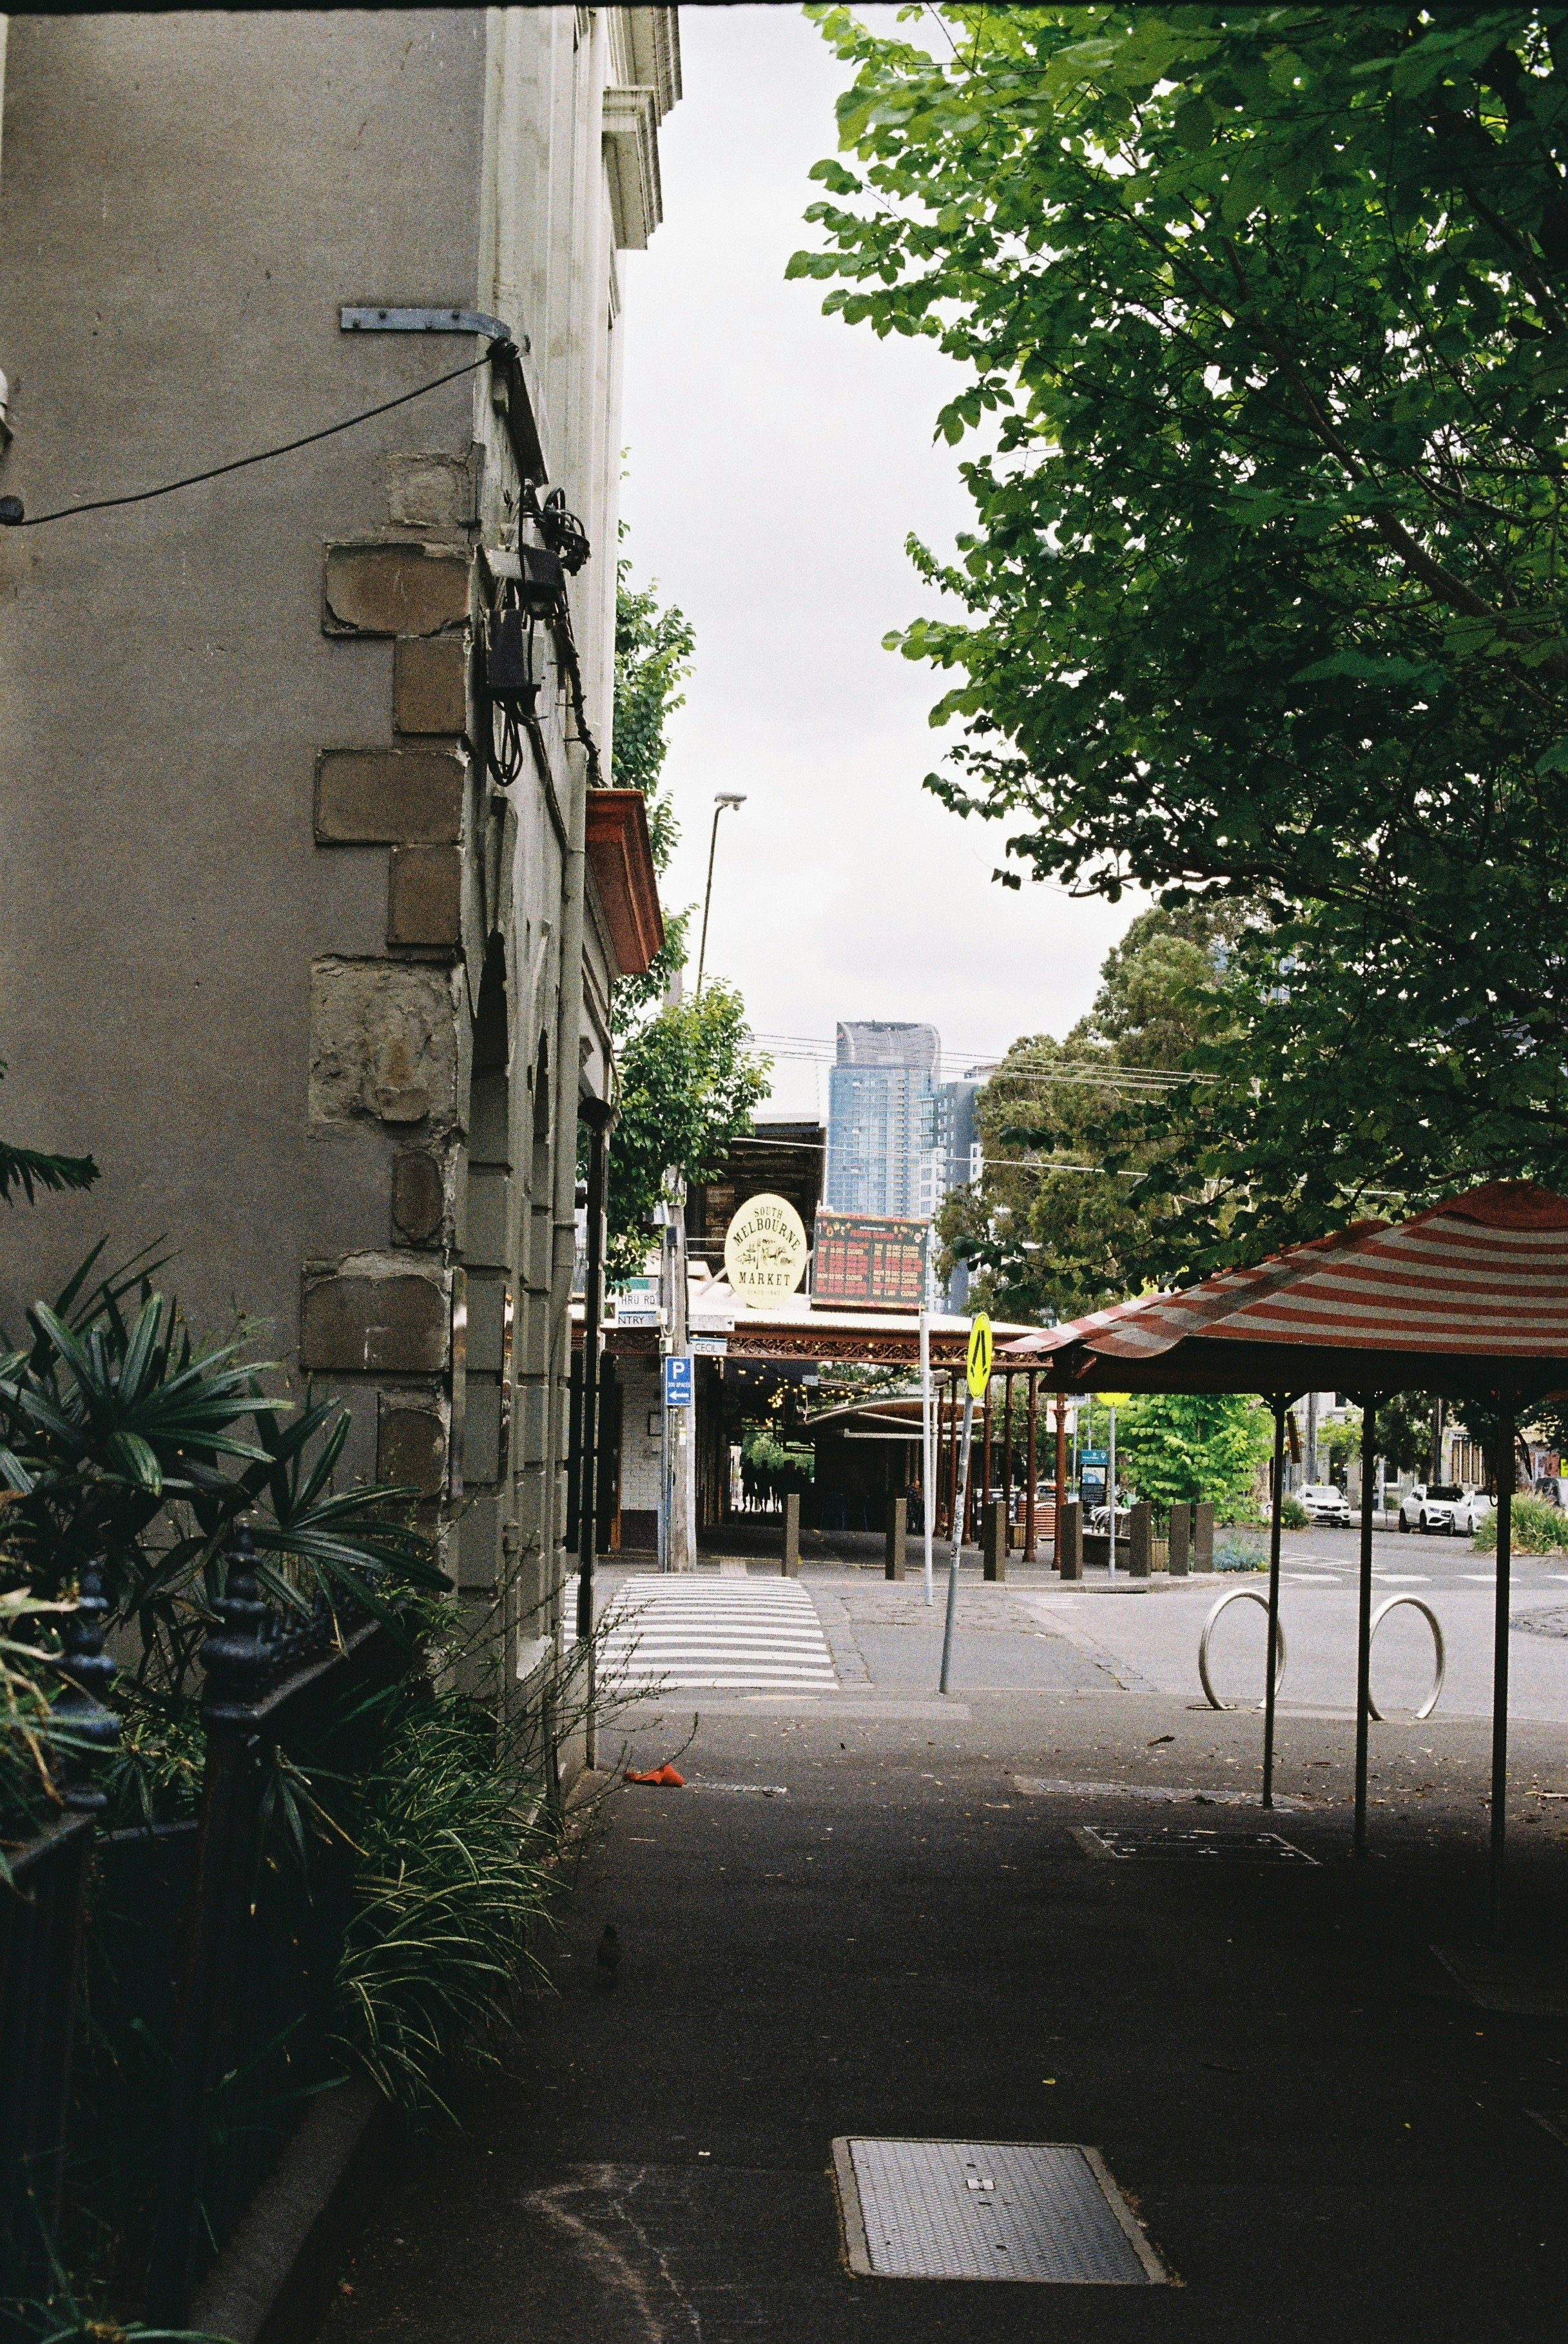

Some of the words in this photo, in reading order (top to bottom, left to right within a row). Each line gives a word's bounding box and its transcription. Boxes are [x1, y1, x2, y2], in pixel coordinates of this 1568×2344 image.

[754, 1206, 783, 1219] SOUTH
[733, 1217, 801, 1252] MELBOURNE
[739, 1272, 790, 1286] MARKET
[619, 1295, 639, 1304] HRU
[644, 1295, 655, 1304] RD
[695, 1343, 717, 1352] CECIL
[673, 1361, 684, 1379] P
